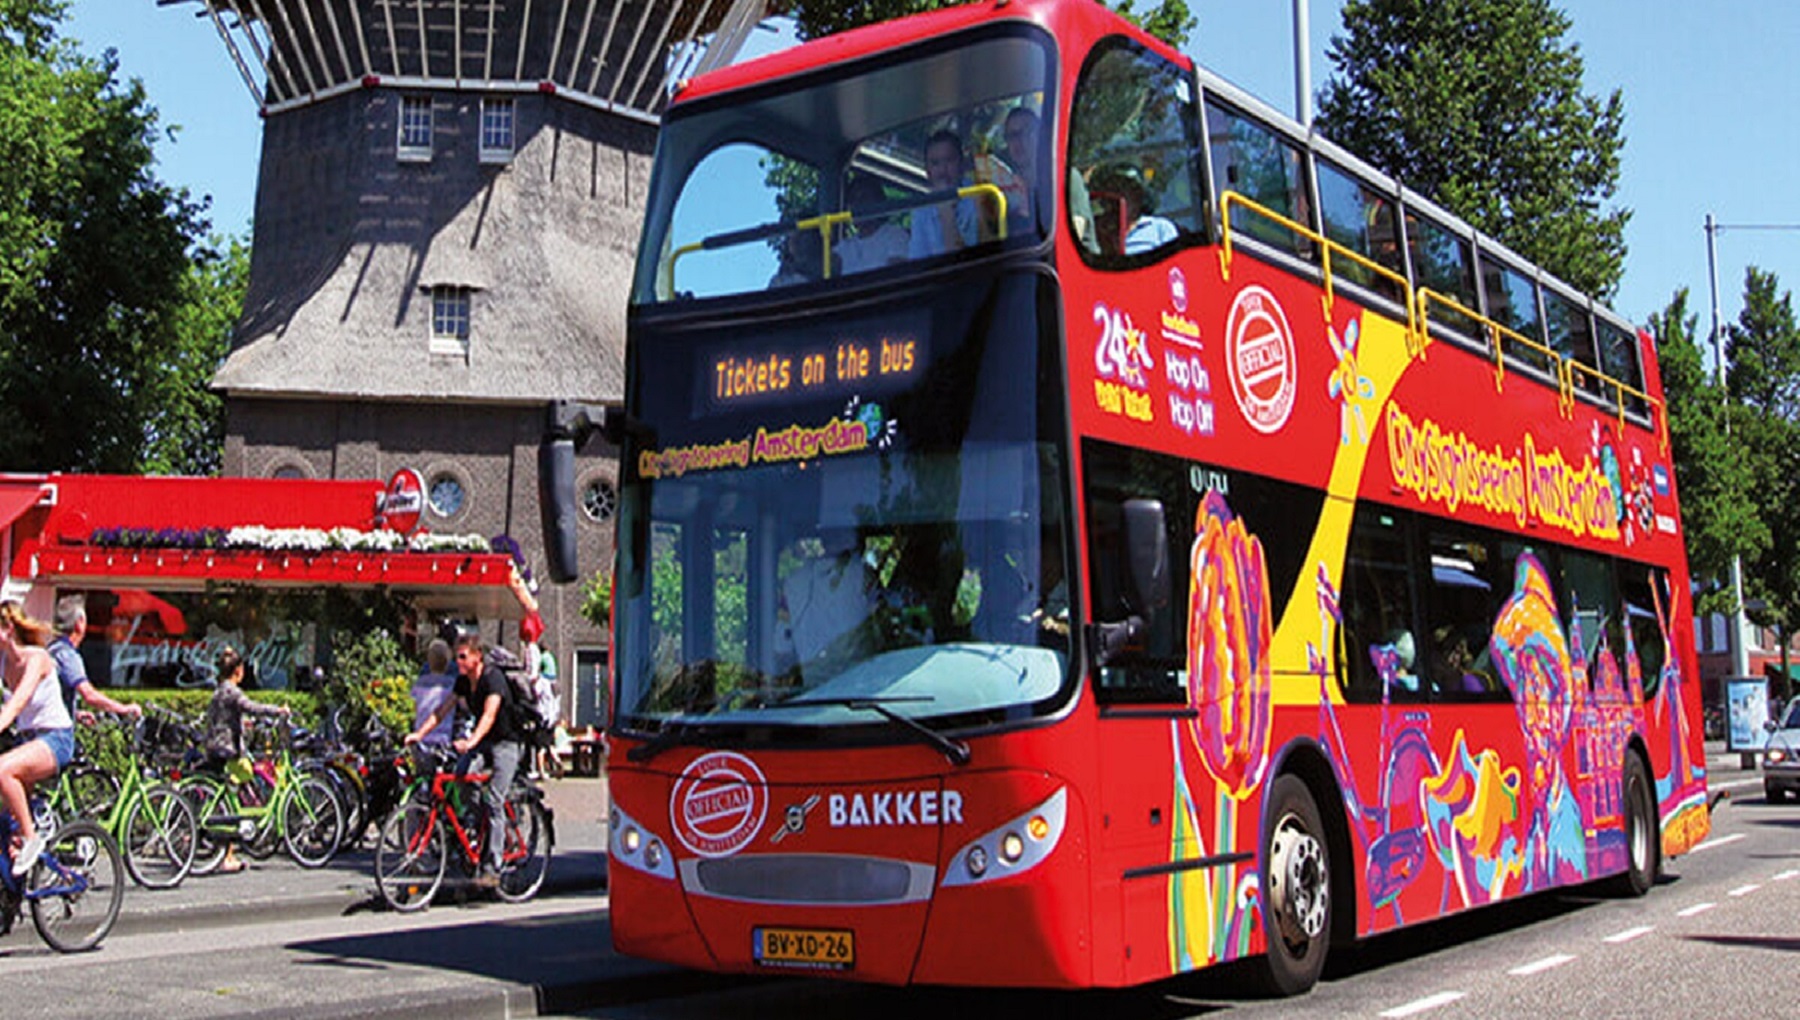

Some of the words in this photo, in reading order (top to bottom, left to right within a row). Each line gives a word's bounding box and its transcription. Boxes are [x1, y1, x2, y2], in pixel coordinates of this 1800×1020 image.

[716, 355, 791, 397] Tickets
[802, 353, 825, 385] on
[836, 345, 869, 380] the
[880, 339, 915, 374] bus
[1165, 351, 1191, 391] Hop
[1191, 355, 1210, 393] On
[1169, 393, 1195, 434] Hop
[752, 417, 867, 462] Amsterdam
[1523, 432, 1620, 540] Amsterdam
[687, 788, 747, 817] OFFICIAL
[828, 790, 963, 826] BAKKER
[768, 932, 849, 958] BV-XD-26
